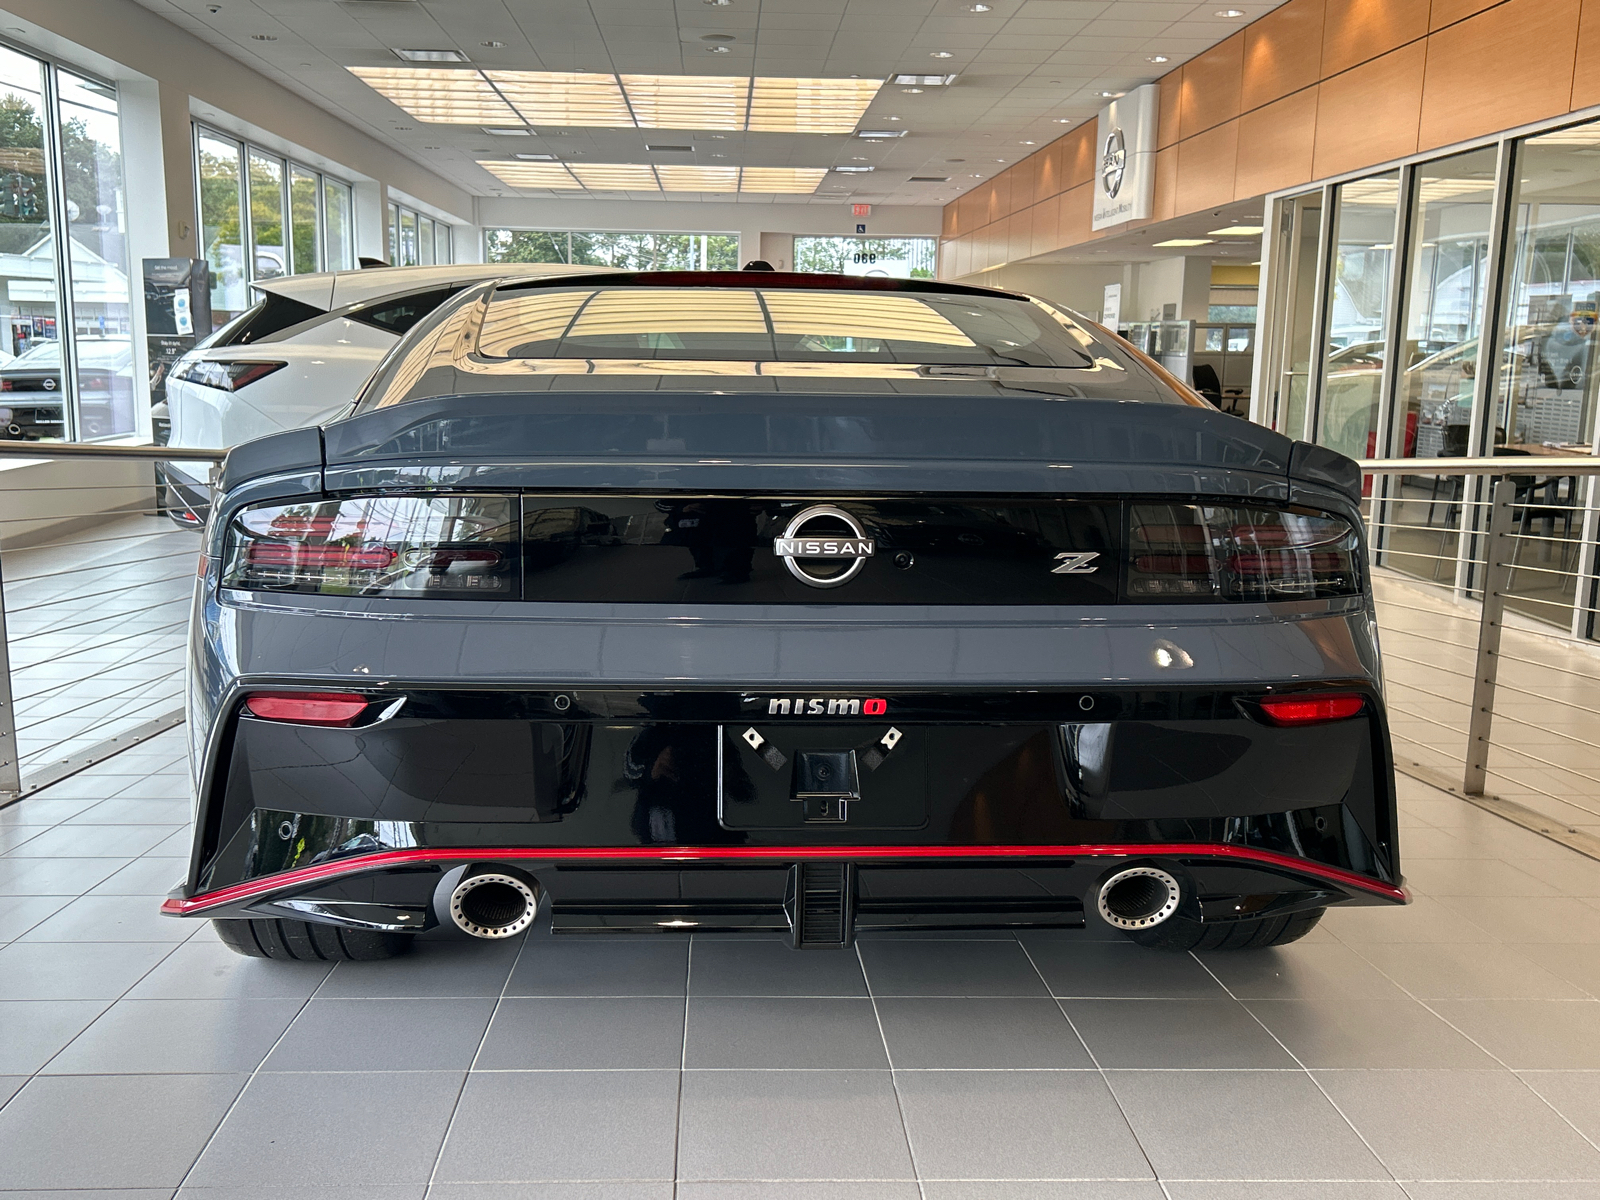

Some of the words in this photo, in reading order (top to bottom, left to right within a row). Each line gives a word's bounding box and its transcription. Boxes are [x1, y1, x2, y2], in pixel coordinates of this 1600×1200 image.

[854, 204, 870, 216] EXIT
[779, 541, 873, 555] NISSAN
[1051, 552, 1100, 574] Z
[768, 697, 888, 715] nismo
